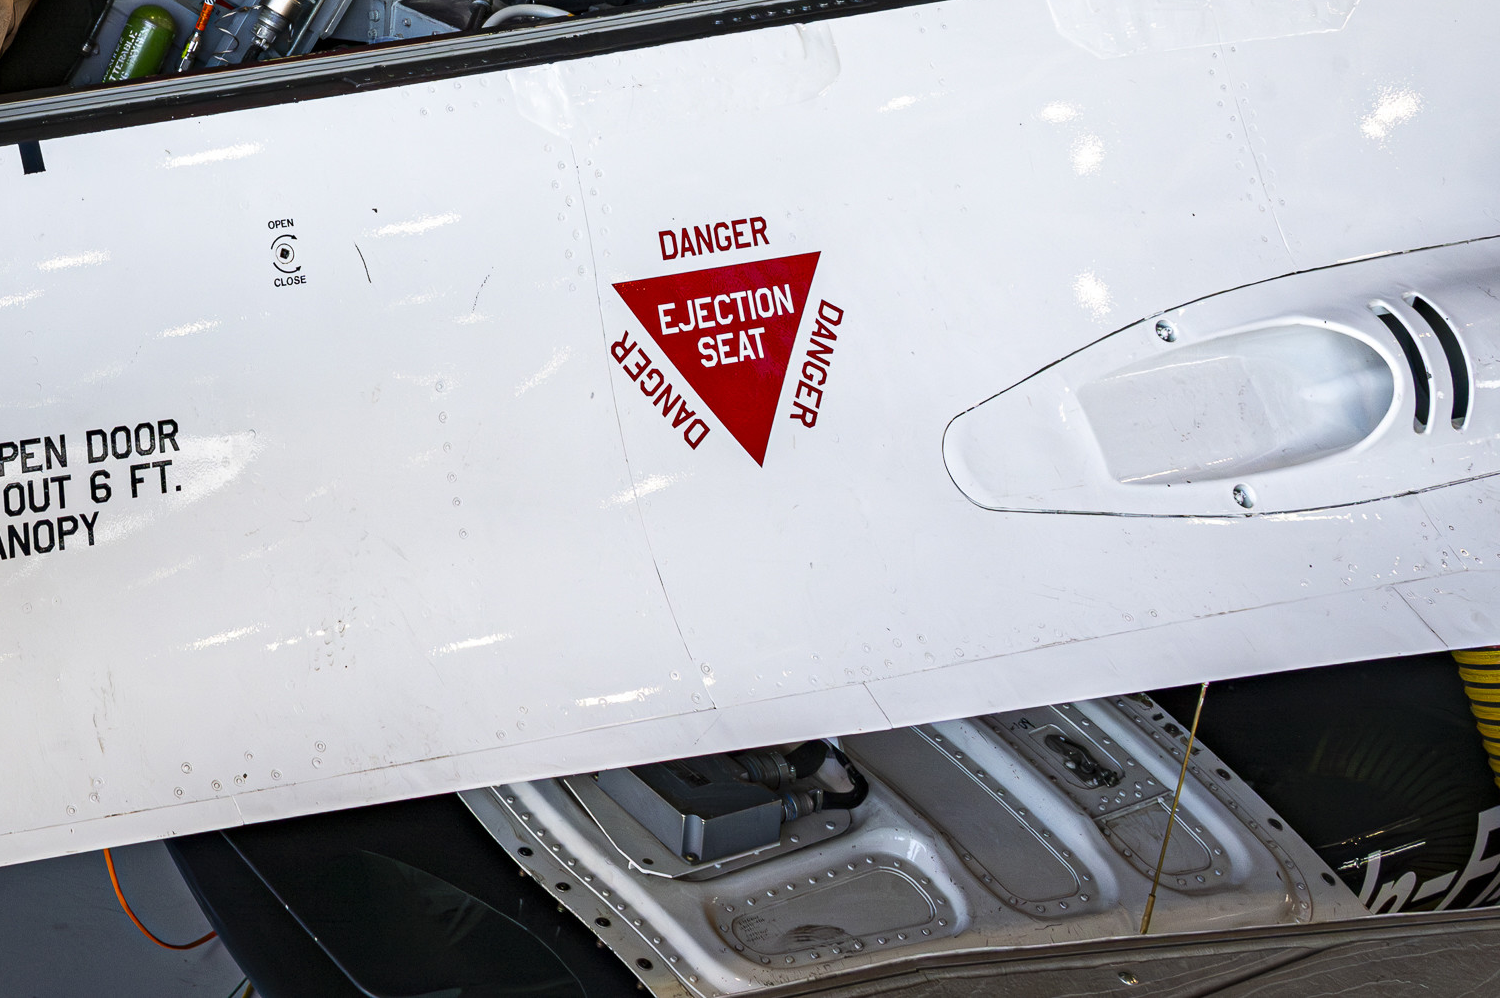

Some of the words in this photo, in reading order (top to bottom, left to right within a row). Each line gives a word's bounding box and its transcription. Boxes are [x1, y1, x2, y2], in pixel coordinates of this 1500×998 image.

[268, 219, 294, 230] OPEN
[658, 216, 770, 261] DANGER
[274, 275, 307, 288] CLOSE
[657, 283, 795, 336] EJECTION
[697, 327, 766, 368] SEAT
[789, 299, 844, 429] DANGER
[610, 330, 711, 451] DANGER
[86, 419, 180, 463] DOOR
[4, 475, 71, 517] OUT
[90, 470, 112, 504] 6
[130, 459, 182, 498] FT.
